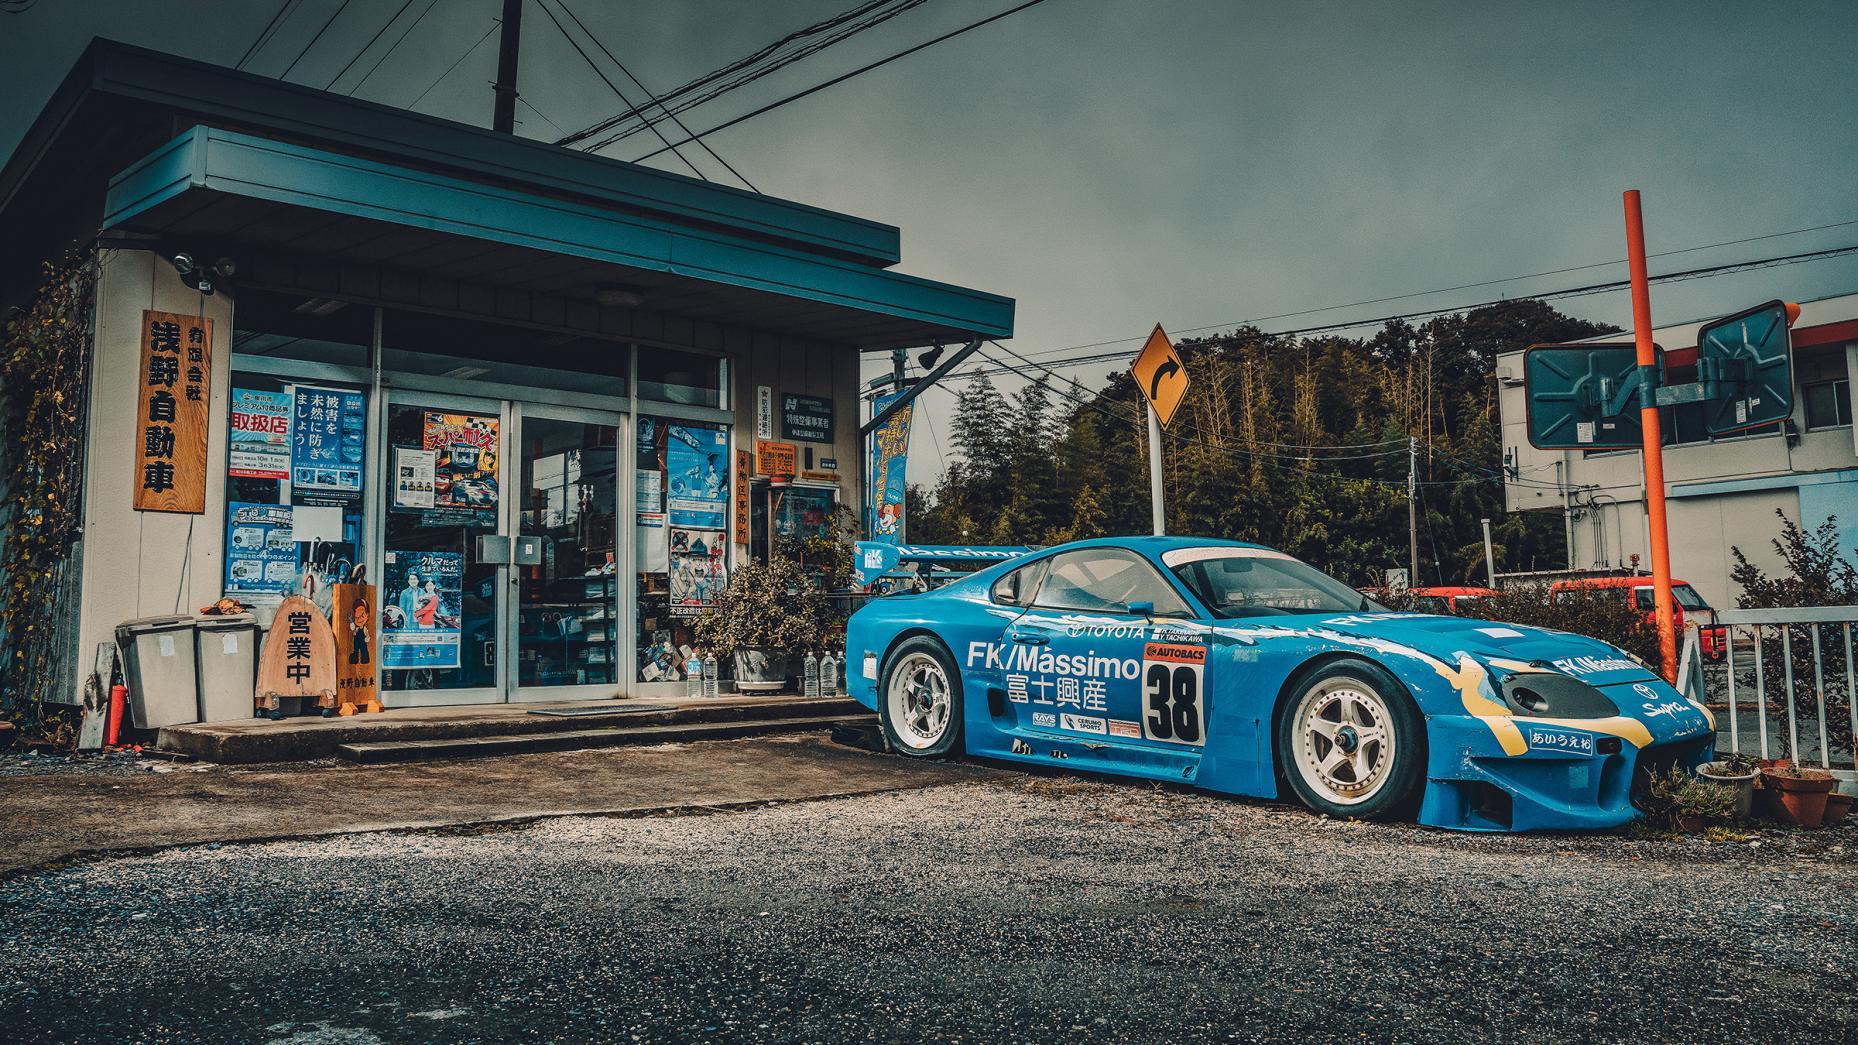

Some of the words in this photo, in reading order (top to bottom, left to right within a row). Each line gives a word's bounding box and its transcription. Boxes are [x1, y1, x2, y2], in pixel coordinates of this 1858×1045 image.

[185, 326, 204, 401] 有限会社
[144, 320, 181, 494] 浅野自動車
[325, 395, 340, 435] 被害を
[231, 412, 289, 434] 取扱店
[308, 394, 325, 460] 未然に防ぎ
[1087, 625, 1145, 639] TOYOTA
[287, 611, 312, 685] 営業中
[1157, 647, 1205, 660] AUTOBACS
[1006, 672, 1108, 712] 富士興産
[1146, 664, 1201, 743] 38
[1641, 701, 1692, 720] Supra
[1032, 712, 1056, 723] RAYS
[1077, 718, 1102, 727] CERUMO
[1079, 723, 1101, 732] SPORTS
[1533, 732, 1591, 750] あいうえお
